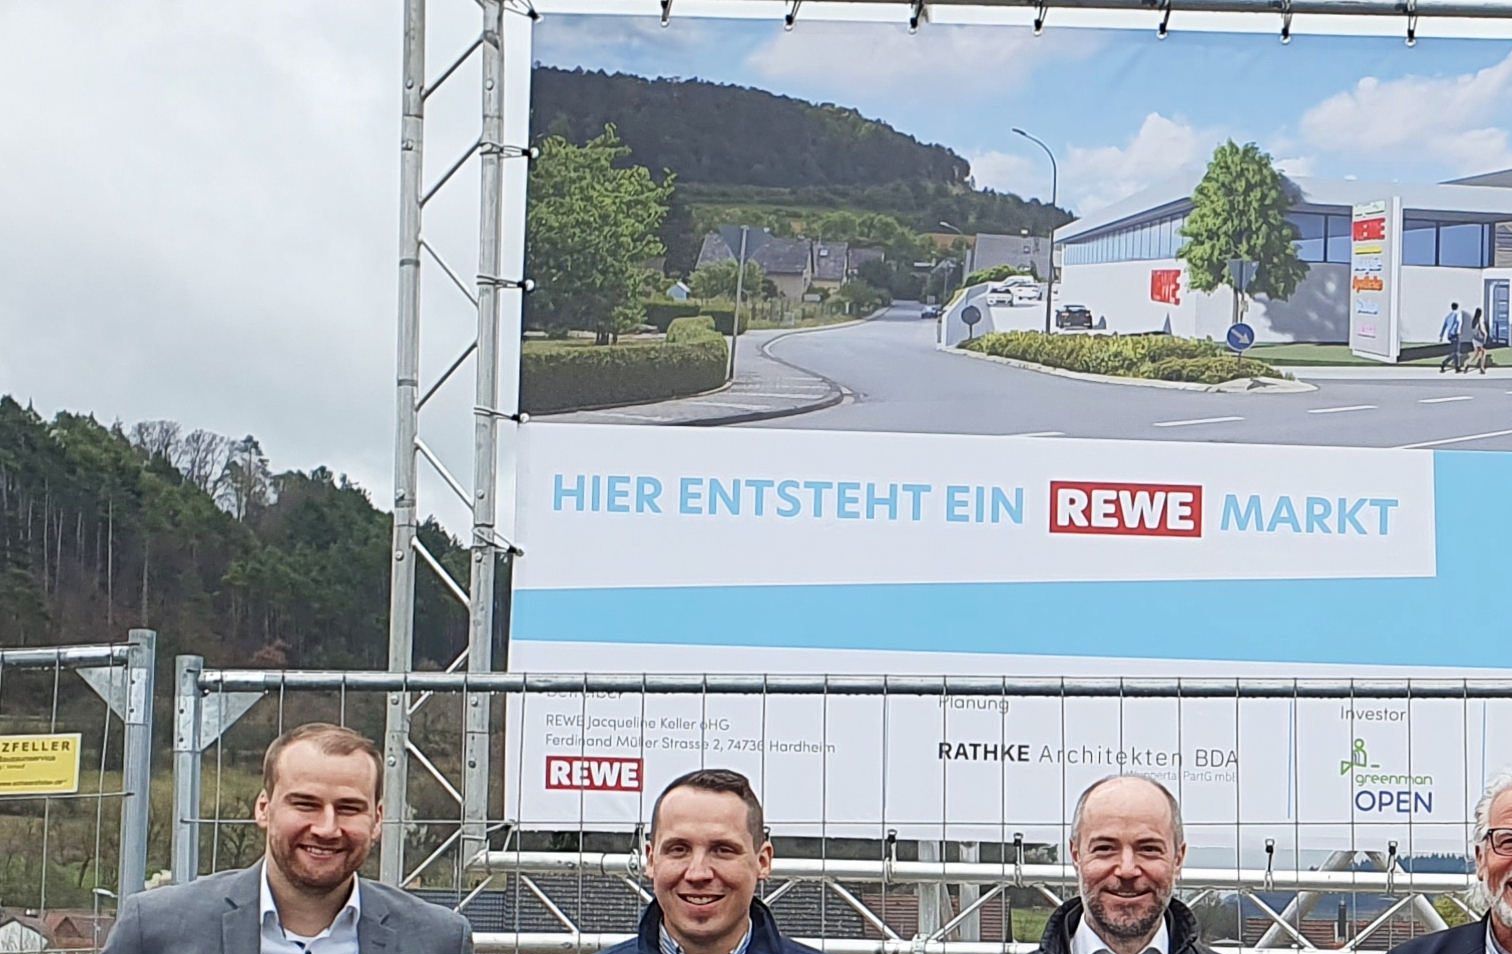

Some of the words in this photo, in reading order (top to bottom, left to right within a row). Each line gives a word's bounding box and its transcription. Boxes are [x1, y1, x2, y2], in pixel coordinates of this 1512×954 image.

[552, 473, 663, 514] HIER
[678, 476, 932, 522] ENTSTEHT
[945, 484, 1025, 525] EIN
[1056, 487, 1195, 531] REWE
[1219, 493, 1399, 536] MARKT
[546, 713, 584, 728] REWE
[586, 714, 656, 731] Jacqueline
[660, 717, 697, 730] Keller
[1340, 705, 1407, 722] Investor
[546, 733, 613, 748] Ferdinand
[616, 735, 659, 749] Müler
[713, 738, 724, 752] 2,
[769, 740, 836, 754] Hardheim
[938, 741, 1031, 763] RATHKE
[1038, 744, 1183, 768] Architekten
[1195, 749, 1239, 769] BDA
[549, 759, 639, 788] REWE
[1355, 773, 1433, 787] greenman
[1355, 790, 1433, 813] OPEN
